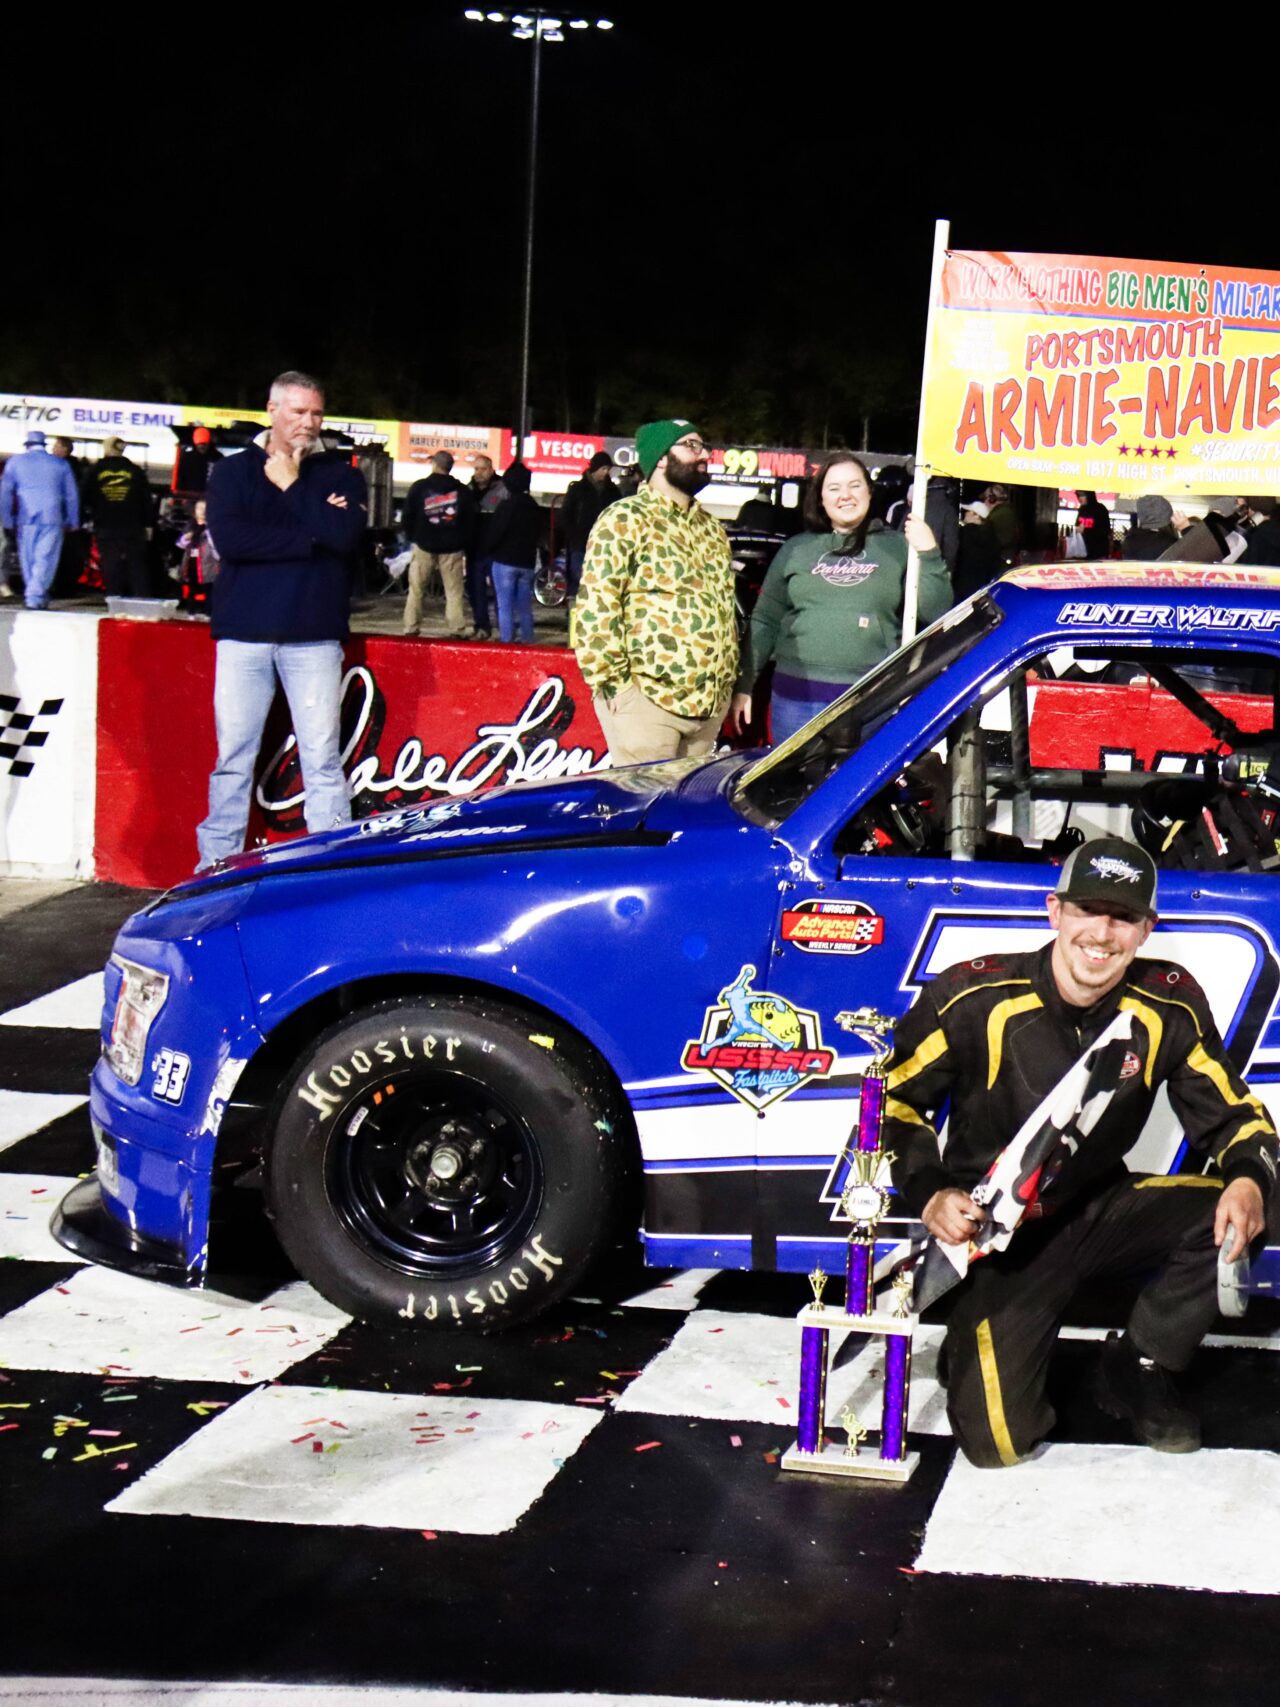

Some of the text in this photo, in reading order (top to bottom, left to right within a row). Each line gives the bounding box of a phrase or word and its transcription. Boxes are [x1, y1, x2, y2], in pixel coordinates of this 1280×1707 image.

[1016, 265, 1104, 306] CLOTHING
[1106, 270, 1141, 309] BIG
[1143, 272, 1208, 315] MEN'S
[1025, 318, 1222, 371] PORTSMOUTH
[409, 436, 440, 448] HARLEY
[541, 440, 596, 460] YESCO
[723, 448, 758, 477] 99
[758, 450, 808, 478] WNOR
[1085, 460, 1115, 477] 1817
[1117, 463, 1148, 481] HIGH
[1057, 603, 1175, 629] HUNTER
[821, 903, 856, 914] NASCAR
[789, 926, 853, 940] Auto Parts
[799, 915, 856, 930] Advance
[808, 941, 856, 951] WEEKLY SERIES
[730, 1041, 773, 1049] VIRGINIA
[685, 1047, 832, 1073] USSSA
[153, 1046, 192, 1106] 33
[298, 1025, 462, 1122] Hoosier
[732, 1066, 800, 1094] Fastpitch
[398, 1232, 563, 1326] Hoosier
